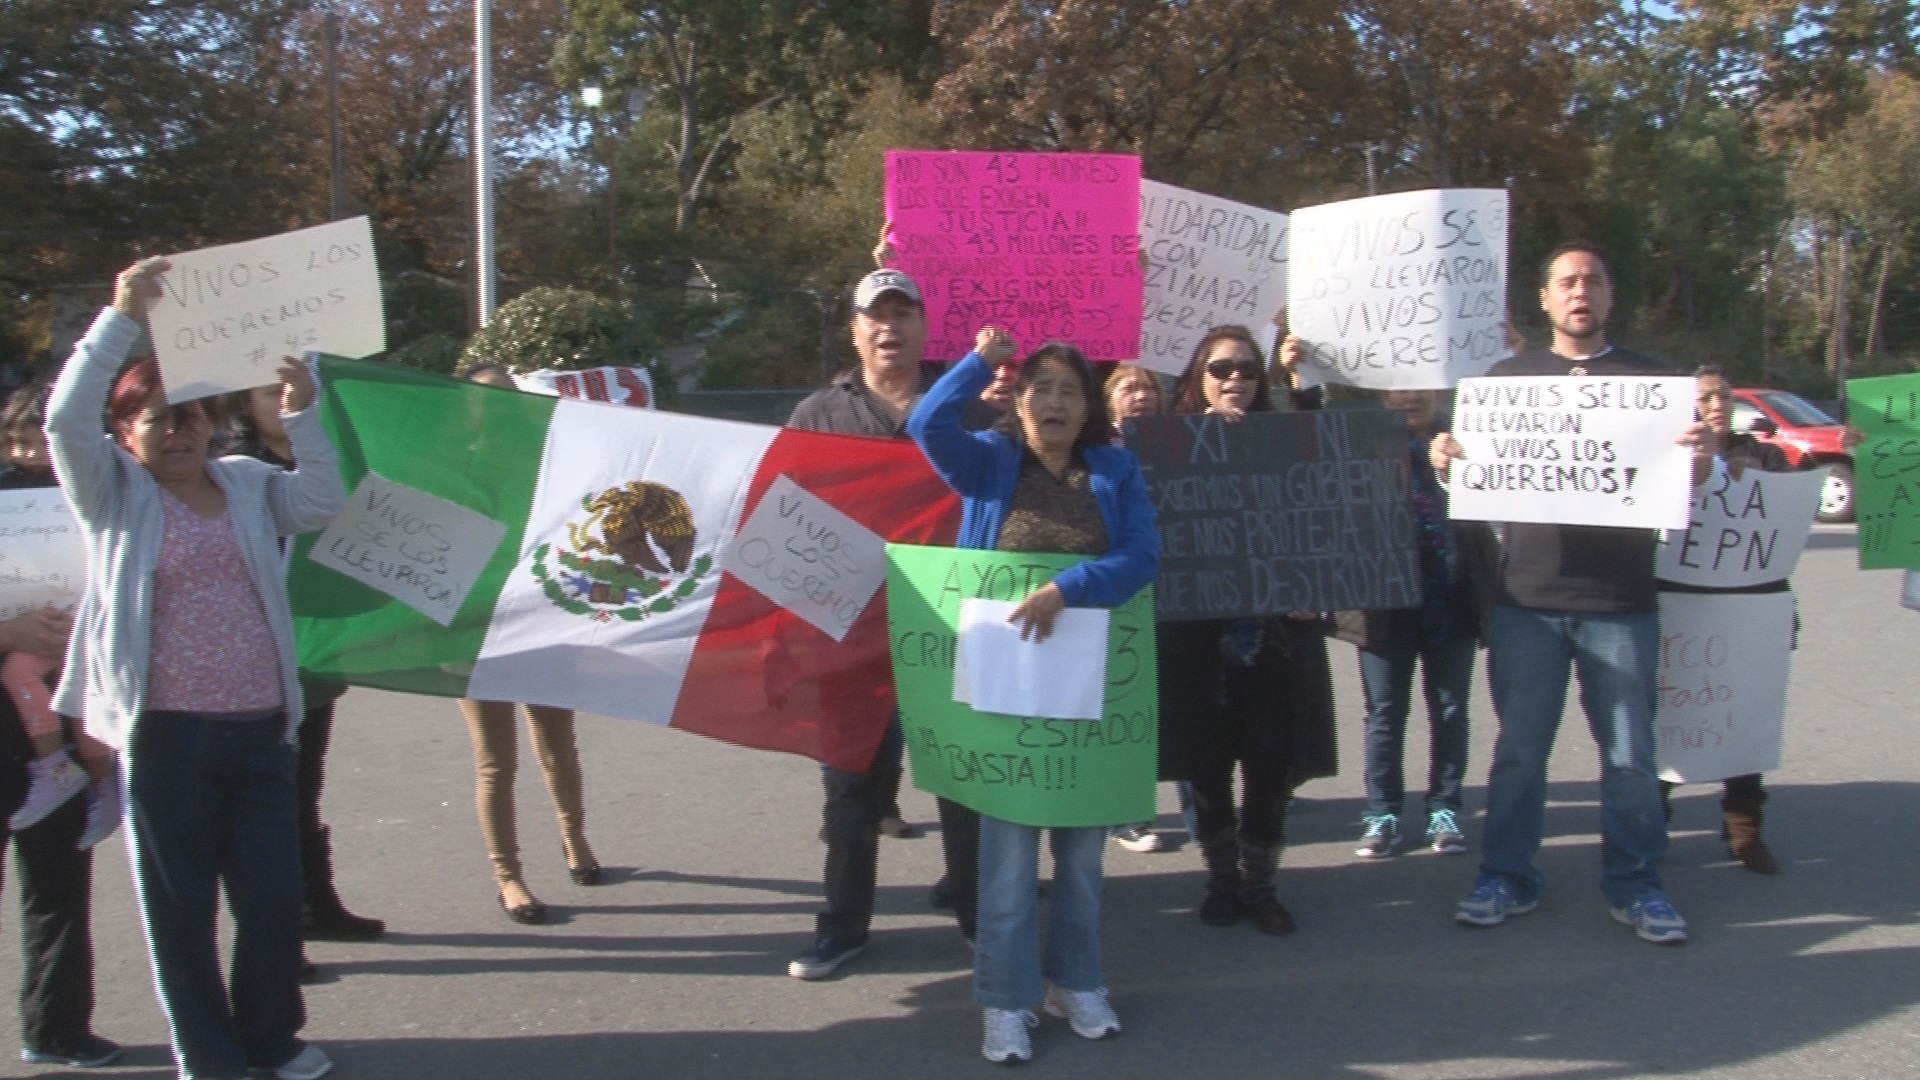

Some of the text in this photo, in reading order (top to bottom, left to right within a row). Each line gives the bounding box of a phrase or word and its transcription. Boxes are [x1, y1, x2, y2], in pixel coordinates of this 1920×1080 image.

[896, 153, 1120, 185] NO SON 43 PADRES
[897, 185, 1050, 211] LOS QUE EXIGEN
[965, 231, 1000, 255] 43
[1007, 232, 1100, 256] MILLONES
[1436, 208, 1480, 249] SE
[905, 256, 1011, 279] IUDADANOS
[1024, 258, 1056, 279] LOS
[1062, 257, 1100, 279] QUE
[1110, 258, 1135, 279] LA
[1150, 239, 1206, 270] CON
[1370, 254, 1500, 290] LLEVARON
[162, 243, 363, 309] VIVOS LOS
[1145, 263, 1259, 317] ZINAPA
[174, 287, 348, 351] QUEREMOS
[943, 320, 1075, 338] MXICO
[944, 300, 1074, 321] AYOTZINAPA
[1332, 292, 1442, 338] VIVOS
[1457, 290, 1498, 320] LOS
[285, 327, 318, 350] 43
[1312, 327, 1501, 372] QUEREMOS
[1462, 411, 1583, 434] LLEVARON
[1491, 436, 1616, 463] VIVOS LOS
[1143, 464, 1244, 512] XIGIMOS
[1251, 472, 1282, 510] UN
[1690, 470, 1766, 519] RA
[366, 489, 453, 553] VIVOS
[778, 494, 863, 575] VIVOS
[1191, 516, 1237, 556] NOS
[355, 520, 449, 576] SE LOS
[785, 534, 842, 582] LOS
[1679, 519, 1780, 572] EPN
[939, 560, 1061, 610] AYOT
[1196, 568, 1242, 612] NOS
[1661, 632, 1731, 669] rco
[1657, 674, 1734, 710] tado
